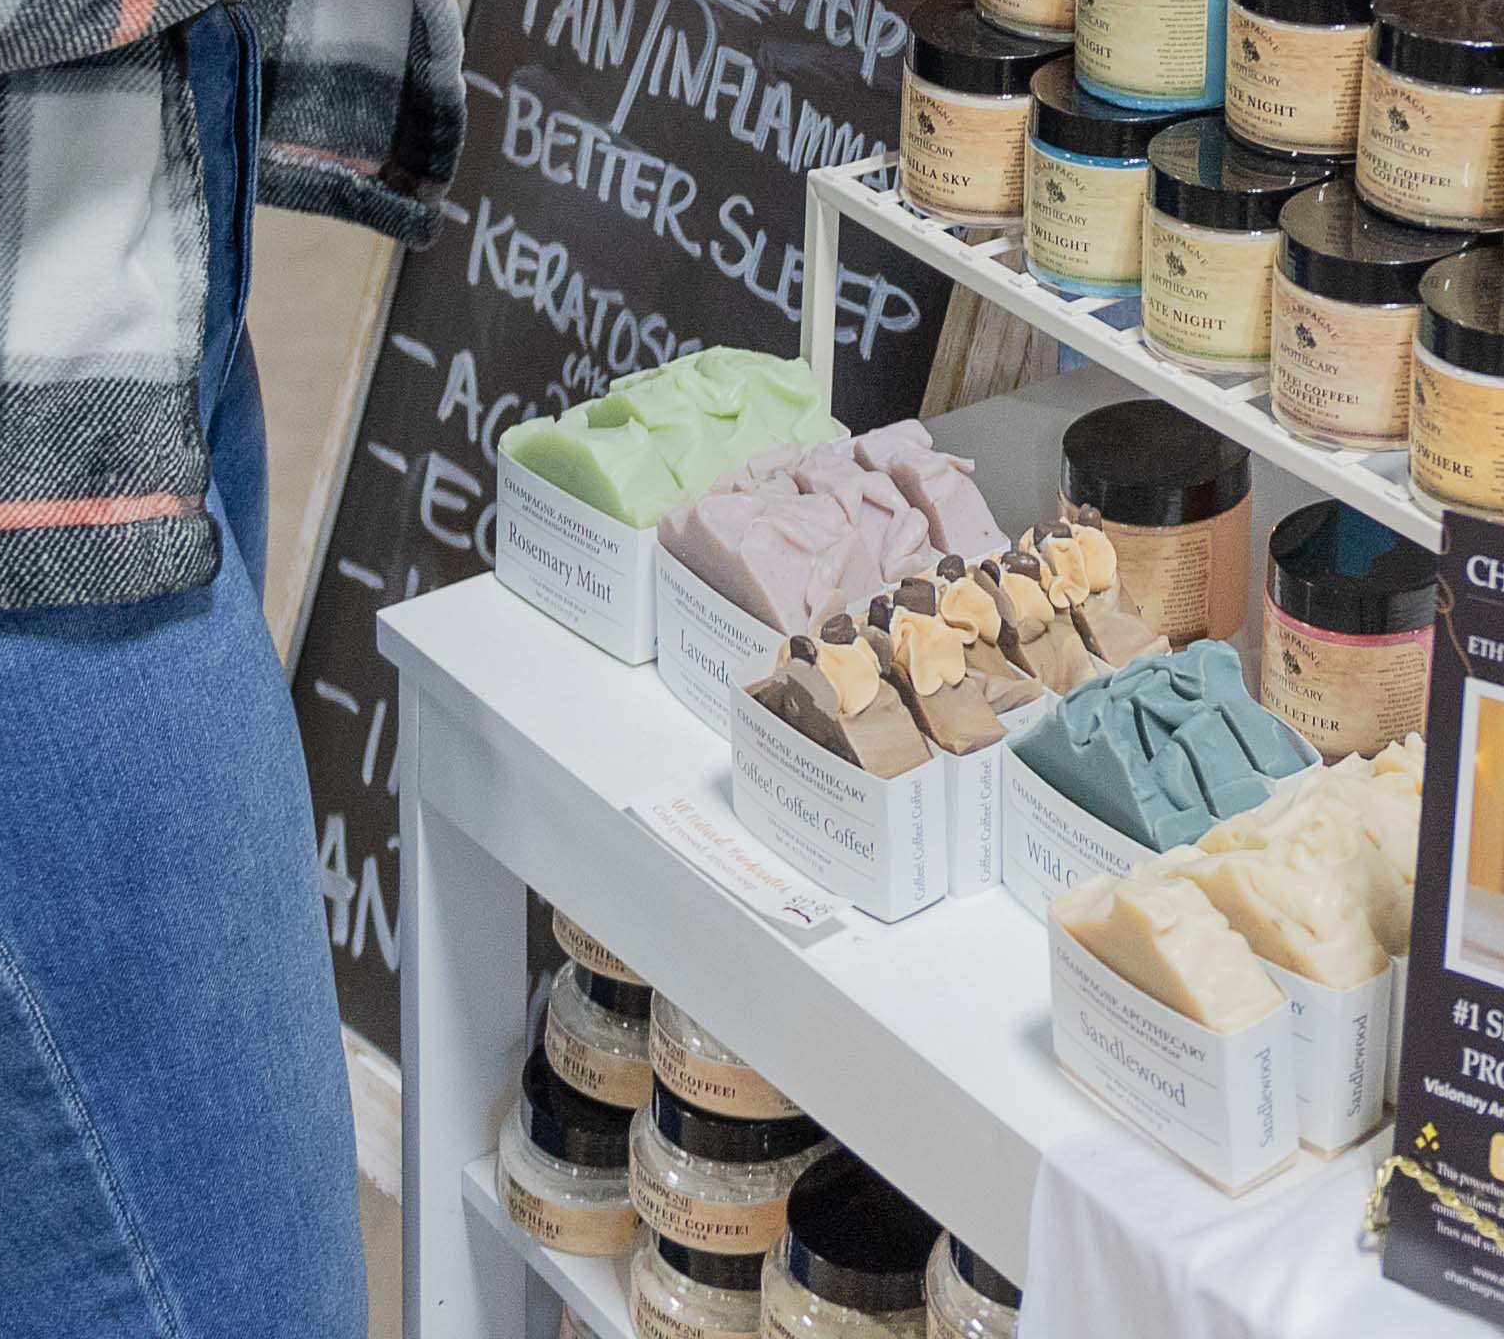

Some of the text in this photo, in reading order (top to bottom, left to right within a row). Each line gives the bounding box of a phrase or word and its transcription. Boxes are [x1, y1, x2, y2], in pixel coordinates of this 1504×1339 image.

[1248, 96, 1297, 118] NIGHT
[942, 173, 972, 187] SKY
[1373, 166, 1419, 192] COFFEE!
[1395, 165, 1451, 187] COFFEE!
[1031, 223, 1091, 252] TWILIGHT
[1173, 310, 1227, 331] NIGHT
[1283, 383, 1328, 409] COFFEE!
[1304, 382, 1360, 405] COFFEE!
[504, 477, 620, 555] CHAMPAGNE APOTHECARY
[509, 521, 572, 587] Rosemary
[576, 565, 611, 603] Mint
[1284, 704, 1340, 731] LETTER
[736, 707, 866, 803] CHAMPAGNE APOTHECARY
[736, 750, 773, 796] Coffee!
[776, 784, 821, 831] Coffee!
[824, 817, 875, 862] Coffee!
[1012, 778, 1070, 834] CHAMPAGNE
[1026, 833, 1061, 883] Wild
[1452, 998, 1480, 1032] #1
[1122, 1003, 1207, 1063] APOTHECARY
[1079, 1011, 1186, 1108] Sandlewood
[1348, 1013, 1368, 1118] Sandlewood
[679, 1071, 737, 1099] COFFEE!
[1255, 1046, 1273, 1149] Sandlewood
[1424, 1076, 1488, 1115] Visionary
[684, 1217, 750, 1236] COFFEE!
